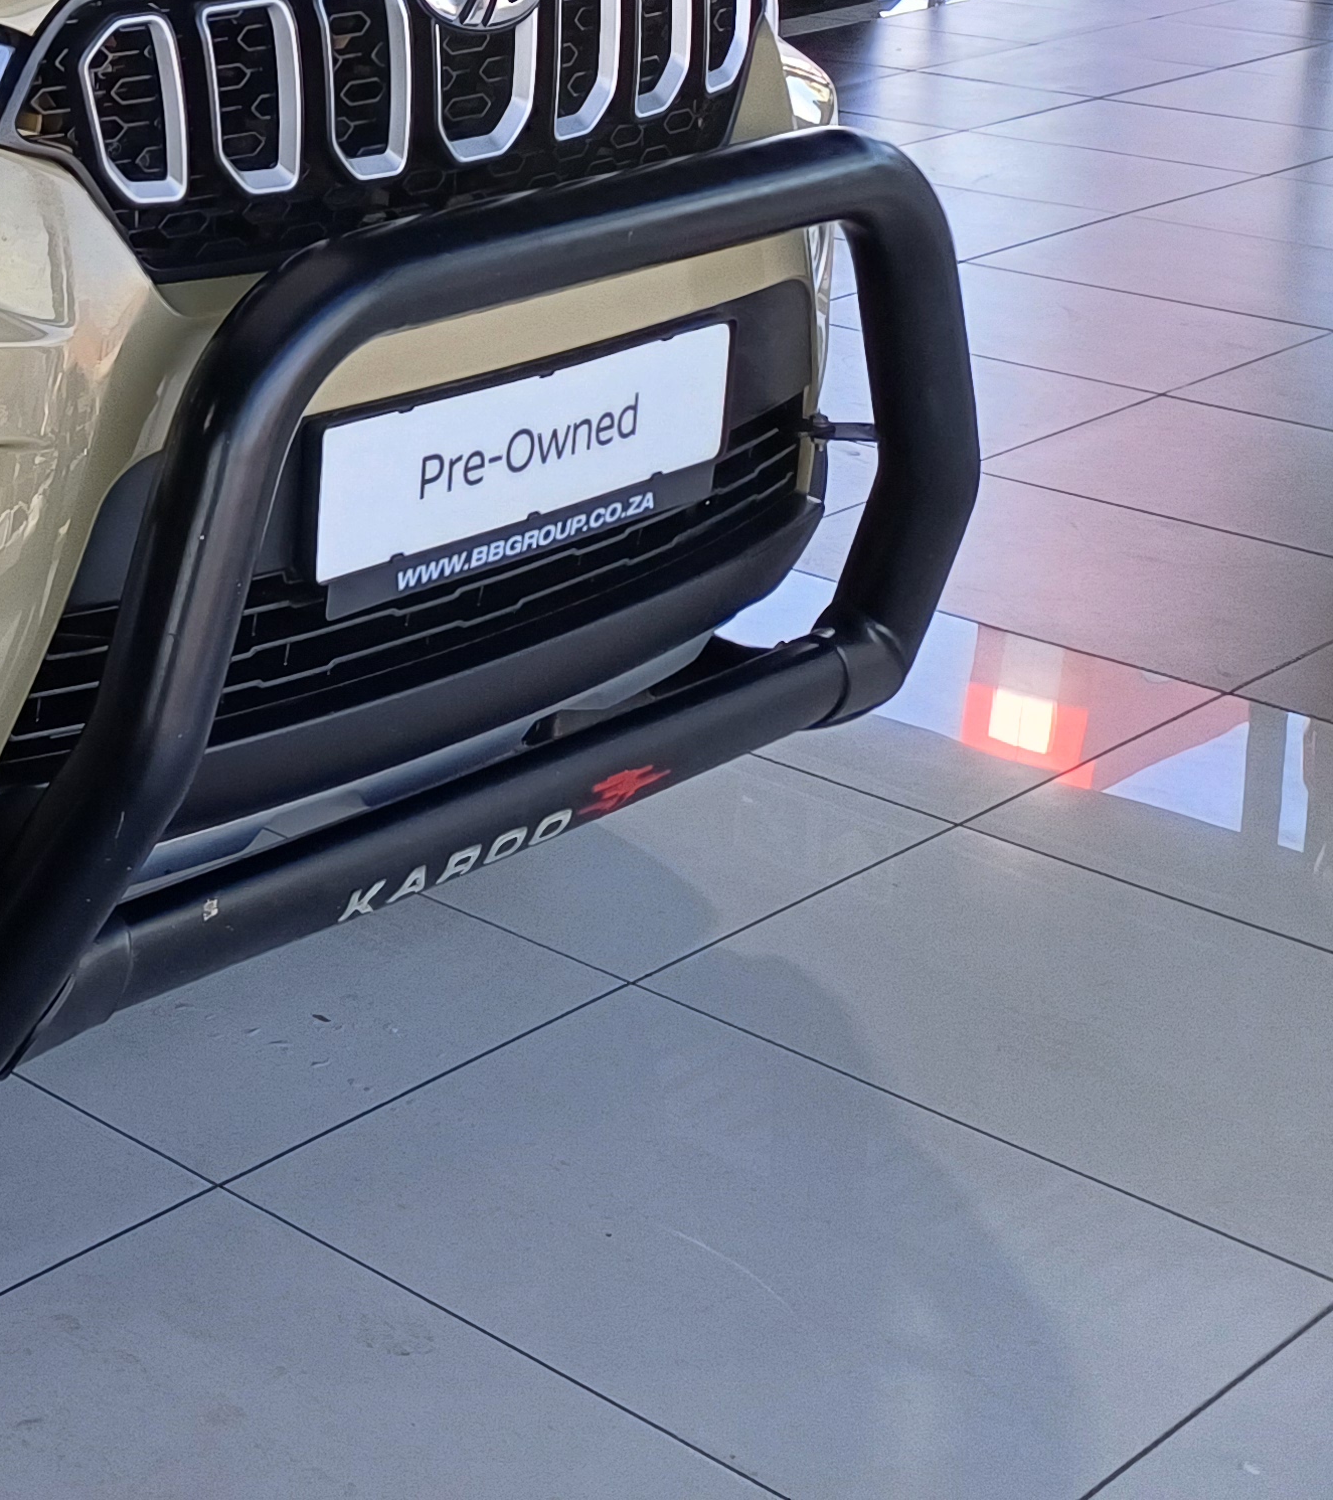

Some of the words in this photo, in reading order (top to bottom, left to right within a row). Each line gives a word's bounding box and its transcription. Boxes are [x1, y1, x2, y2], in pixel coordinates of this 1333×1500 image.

[418, 392, 640, 500] Pre-Owned
[396, 491, 655, 591] WWW.BBGROUP.CO.ZA
[337, 807, 574, 923] KAROO
